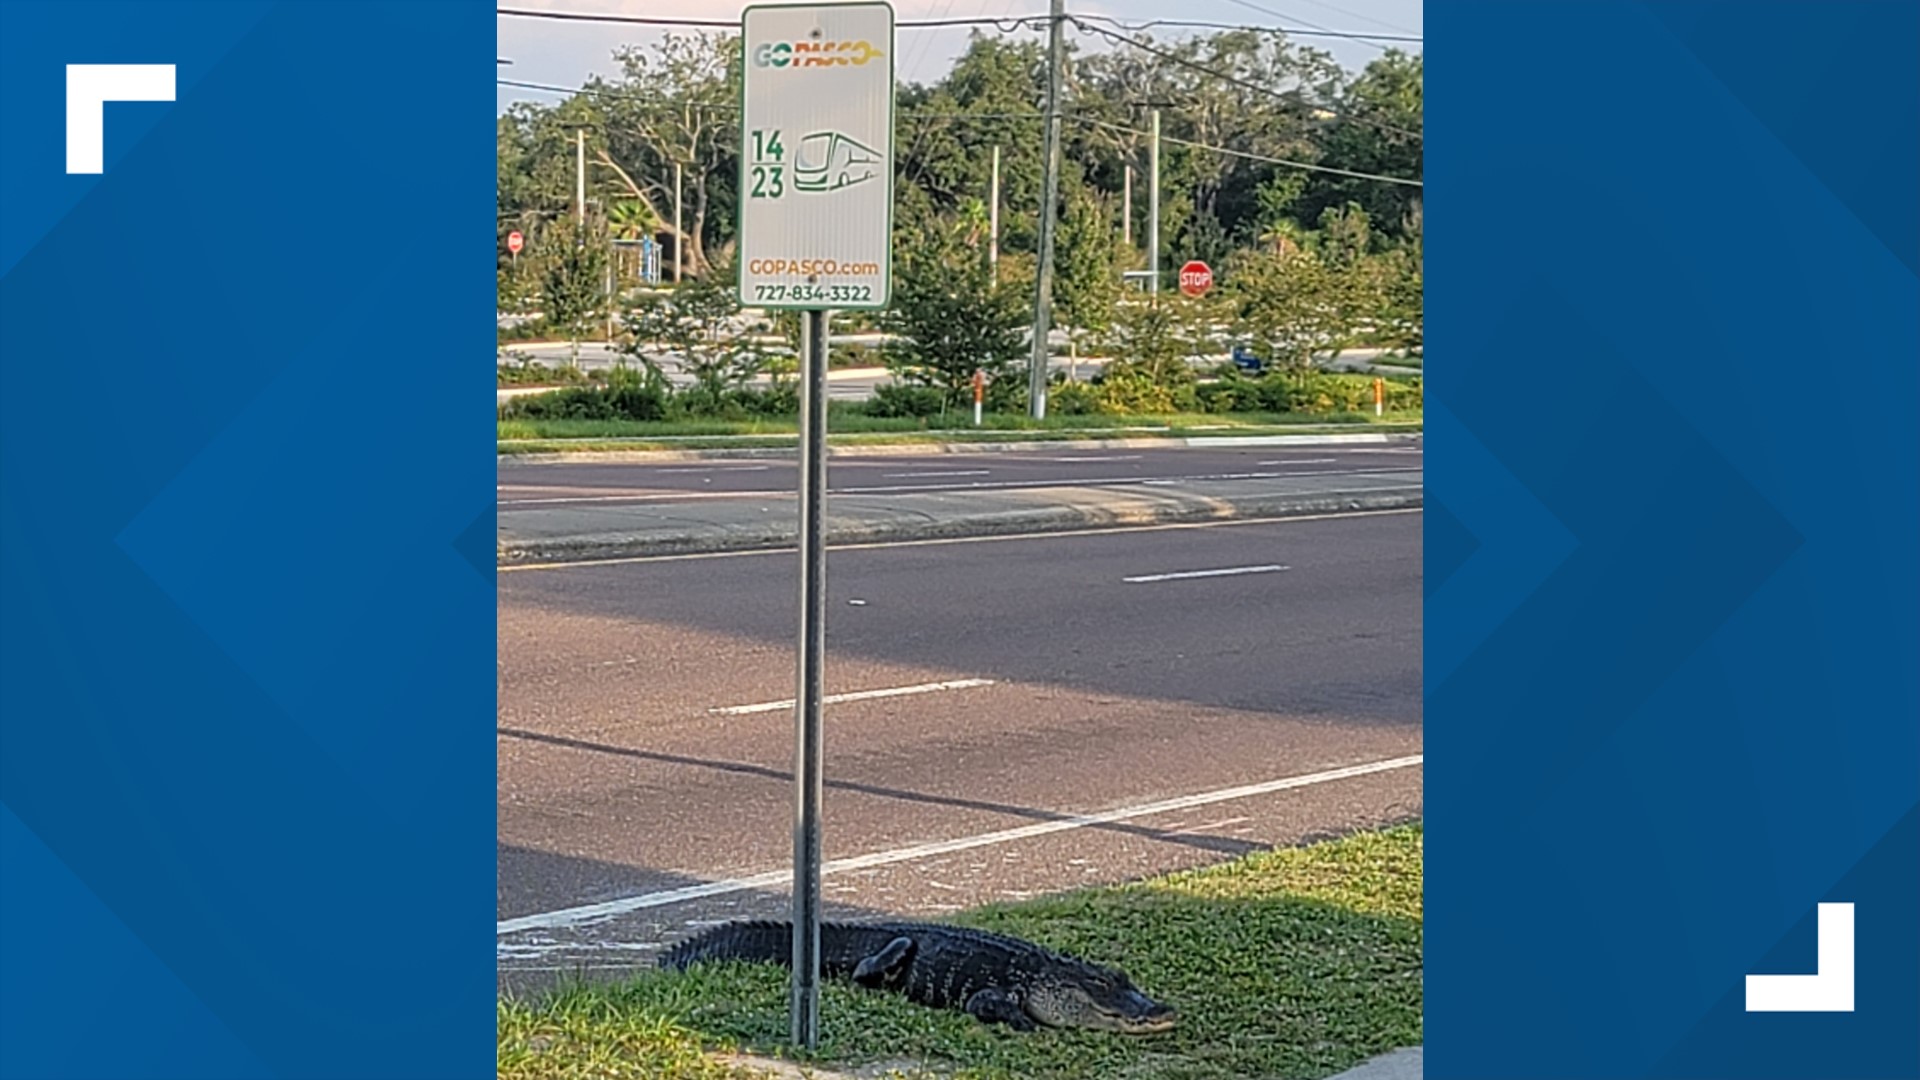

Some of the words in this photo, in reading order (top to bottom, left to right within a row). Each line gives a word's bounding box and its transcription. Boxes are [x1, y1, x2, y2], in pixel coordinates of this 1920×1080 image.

[754, 41, 883, 67] GOPASCO
[752, 130, 784, 162] 14
[751, 167, 783, 198] 23
[750, 260, 879, 275] GOPASCO.com
[1181, 272, 1210, 286] STOP
[755, 286, 871, 301] 727-834-3322
